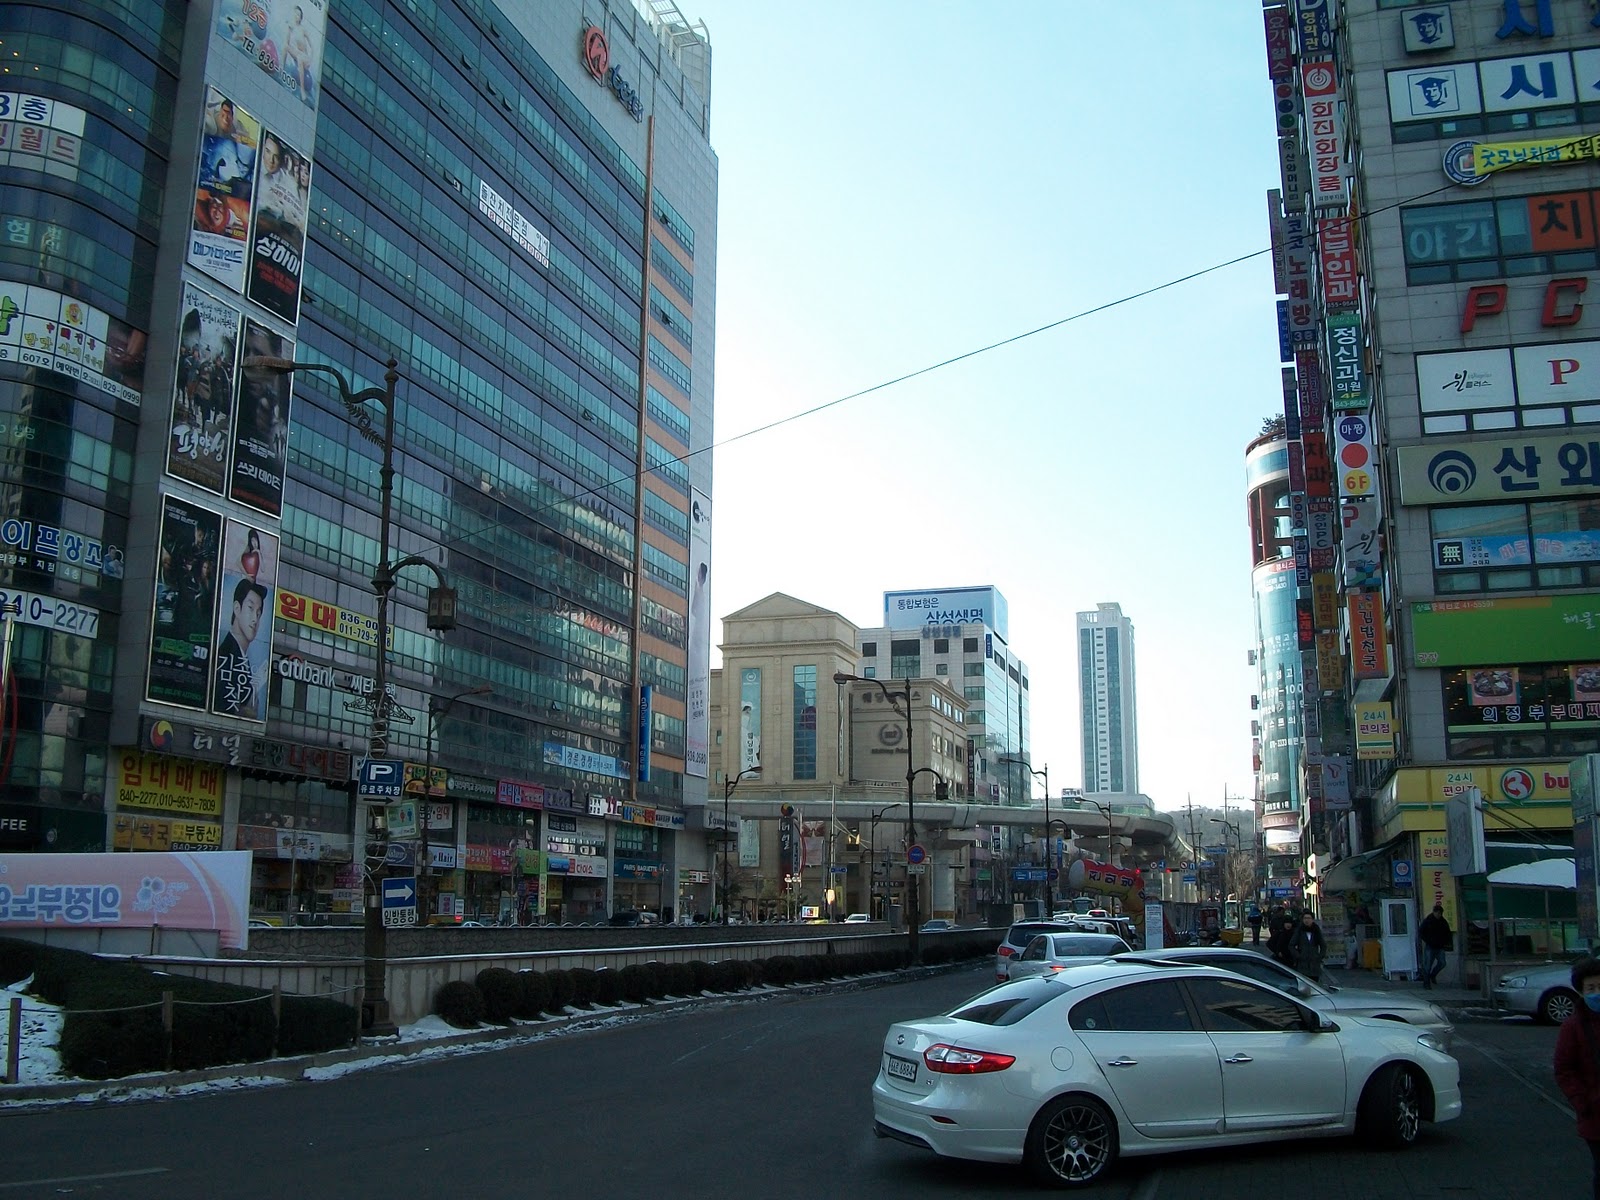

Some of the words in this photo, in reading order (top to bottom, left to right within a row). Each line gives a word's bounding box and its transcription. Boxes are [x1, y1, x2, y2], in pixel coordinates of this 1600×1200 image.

[193, 241, 243, 264] 메가마인드
[256, 237, 301, 277] 상하이
[1323, 221, 1355, 298] 산부인과
[1333, 326, 1361, 381] 정신과
[1547, 358, 1581, 386] P
[1337, 381, 1361, 392] 의원
[1346, 475, 1368, 489] 6F
[1442, 545, 1463, 564] 無
[280, 593, 337, 631] 임대
[897, 597, 939, 611] 통합보험은
[340, 611, 391, 635] 836-009
[926, 608, 984, 625] 삼성생명
[1359, 611, 1377, 668] 김밥천국
[193, 645, 208, 660] 3D
[279, 659, 336, 688] citibank
[350, 675, 396, 695] 씨티행
[223, 680, 257, 713] 찾기
[1363, 711, 1386, 721] 24시
[1482, 705, 1545, 722] 의정부
[1359, 723, 1390, 735] 편의점
[369, 765, 393, 780] P
[1447, 772, 1473, 783] 24시
[1544, 773, 1569, 789] bu
[360, 784, 400, 796] 유료주차장
[185, 824, 216, 844] 부동산
[384, 909, 415, 926] 일방통행
